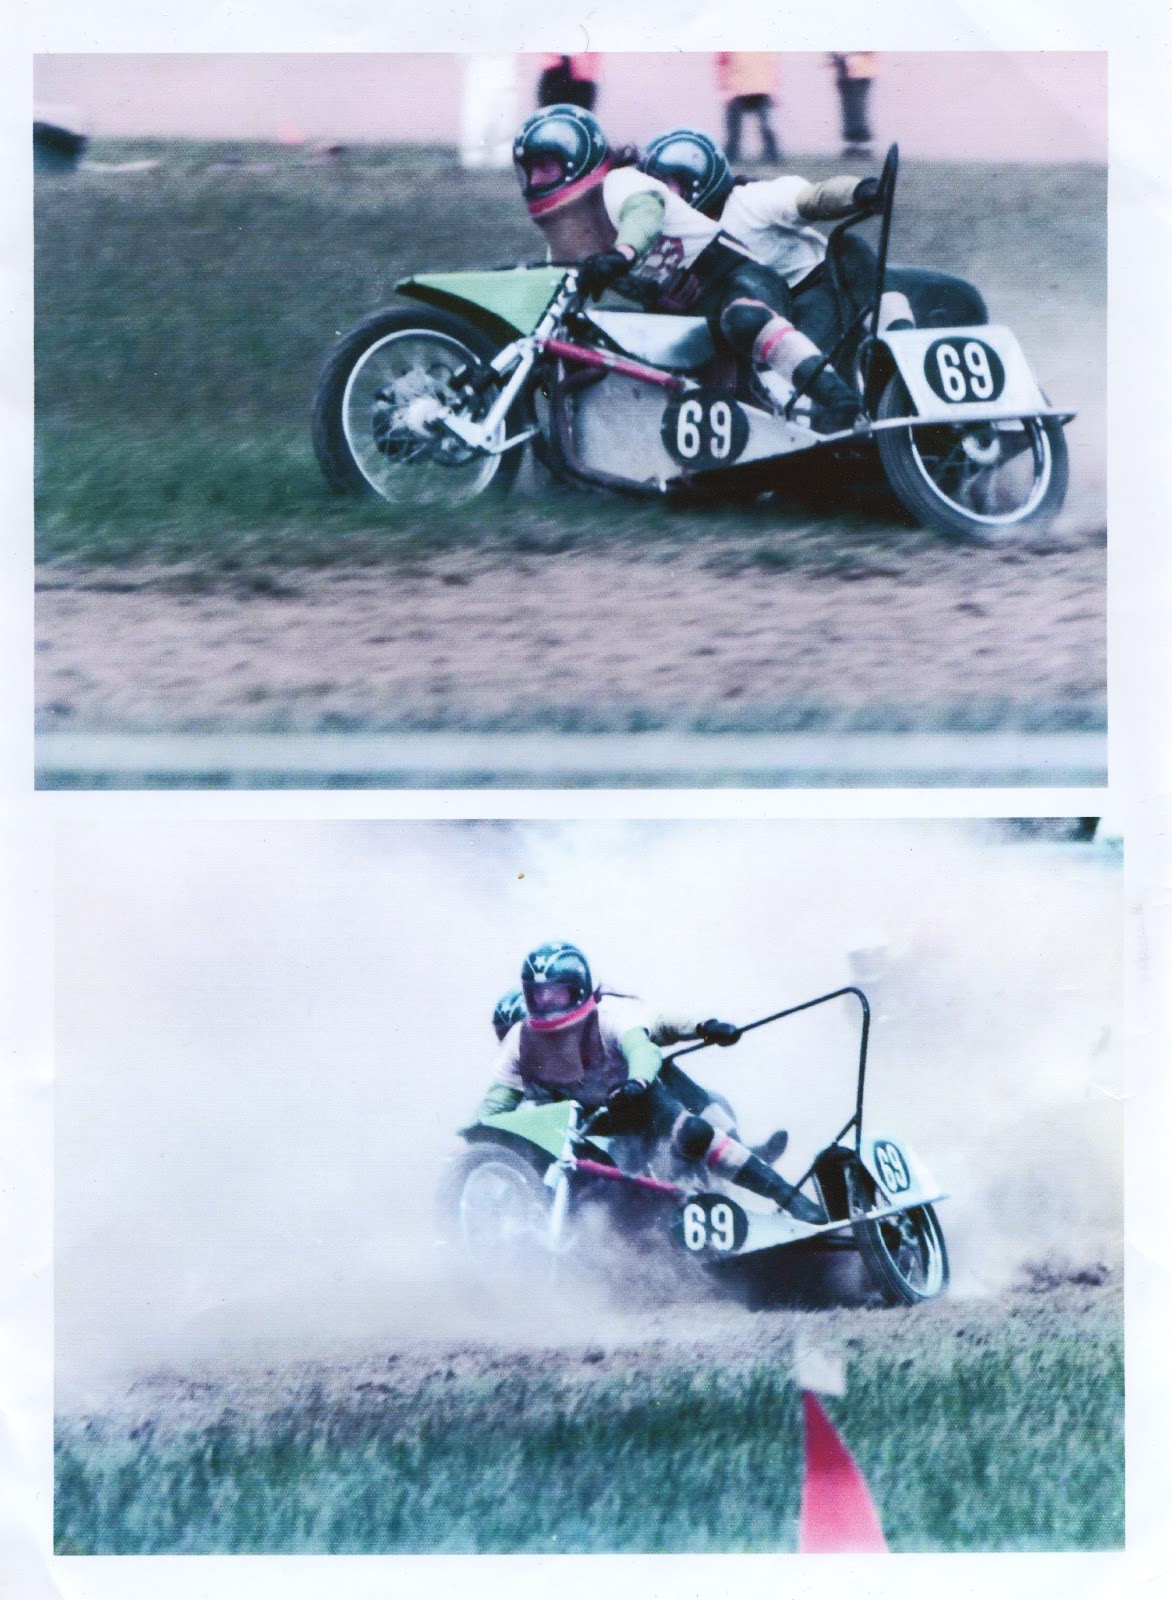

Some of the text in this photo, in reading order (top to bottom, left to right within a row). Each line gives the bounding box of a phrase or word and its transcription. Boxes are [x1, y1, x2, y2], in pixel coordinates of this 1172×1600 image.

[936, 343, 994, 401] 69
[677, 399, 732, 458] 69
[876, 1143, 908, 1191] 69
[683, 1203, 734, 1251] 69
